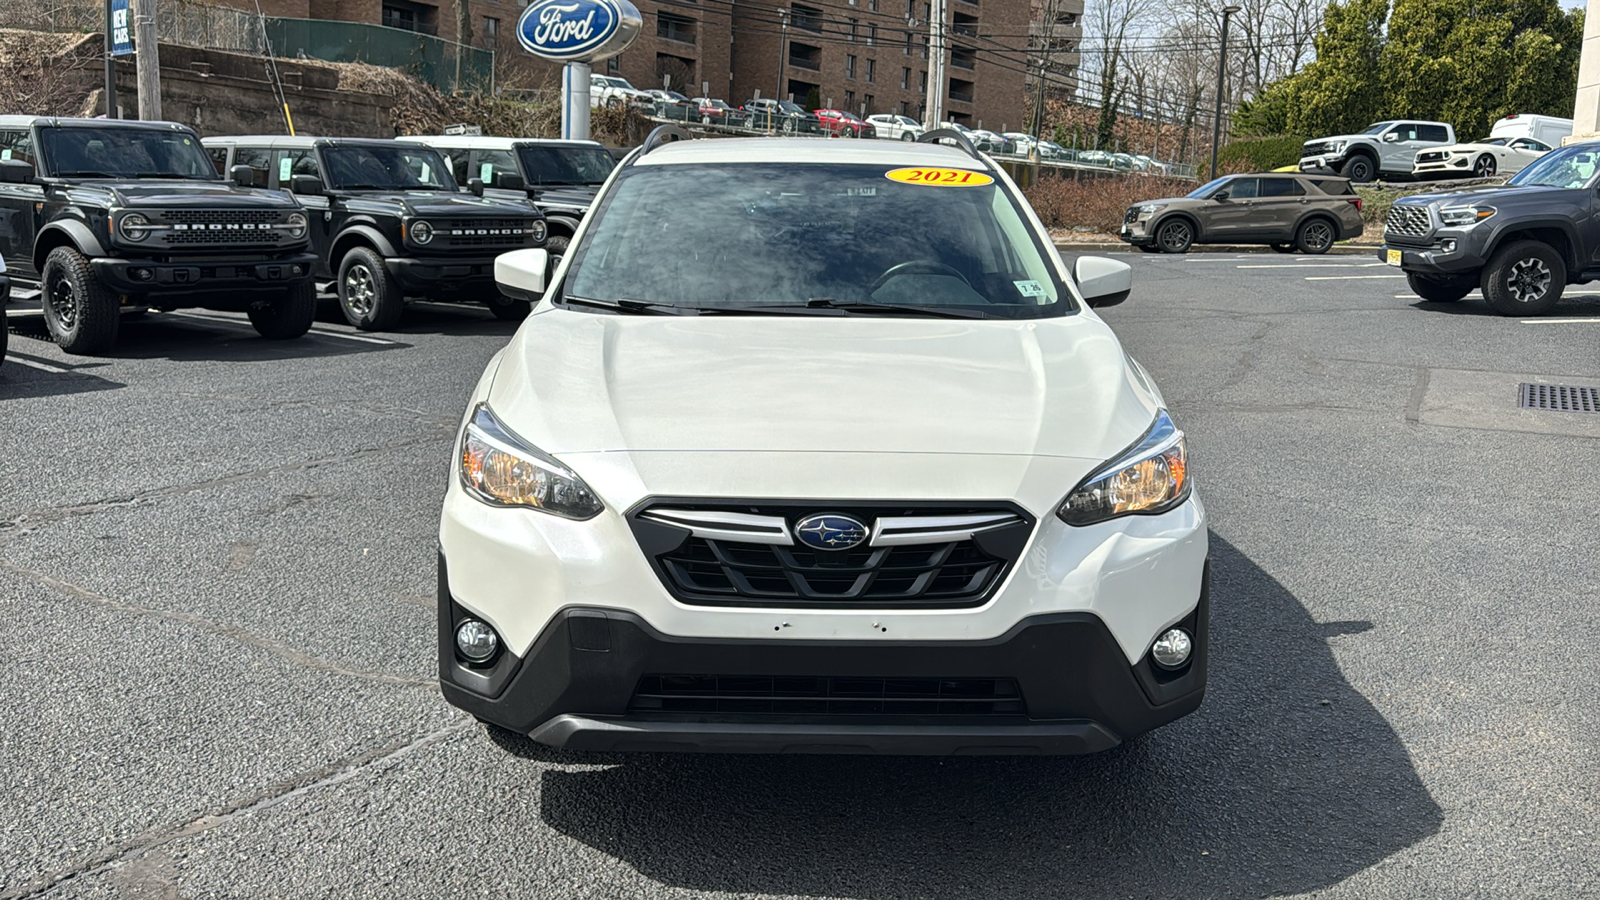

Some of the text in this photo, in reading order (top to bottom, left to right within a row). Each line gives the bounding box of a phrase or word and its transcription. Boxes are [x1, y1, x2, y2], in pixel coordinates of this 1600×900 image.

[113, 8, 127, 28] NEW
[534, 3, 596, 45] Ford
[113, 27, 129, 44] CARS
[906, 170, 973, 183] 2021
